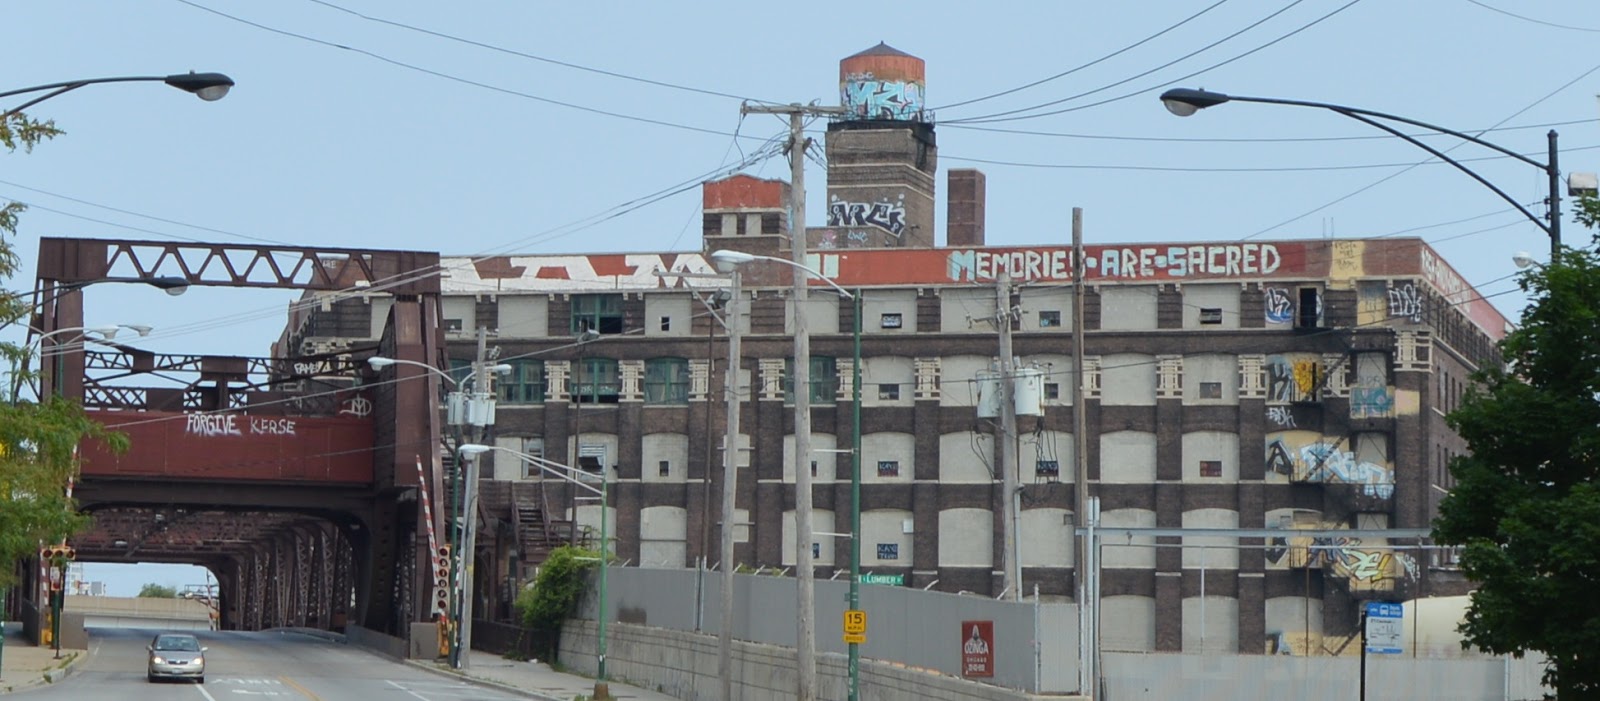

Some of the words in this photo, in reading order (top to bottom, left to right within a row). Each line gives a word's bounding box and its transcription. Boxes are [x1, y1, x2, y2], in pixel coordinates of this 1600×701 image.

[1101, 248, 1157, 278] ARE
[1167, 244, 1281, 276] SACRED
[186, 414, 242, 436] FORGIVE
[250, 416, 296, 435] KERSE
[866, 575, 896, 585] LUMBER
[848, 613, 863, 624] 15
